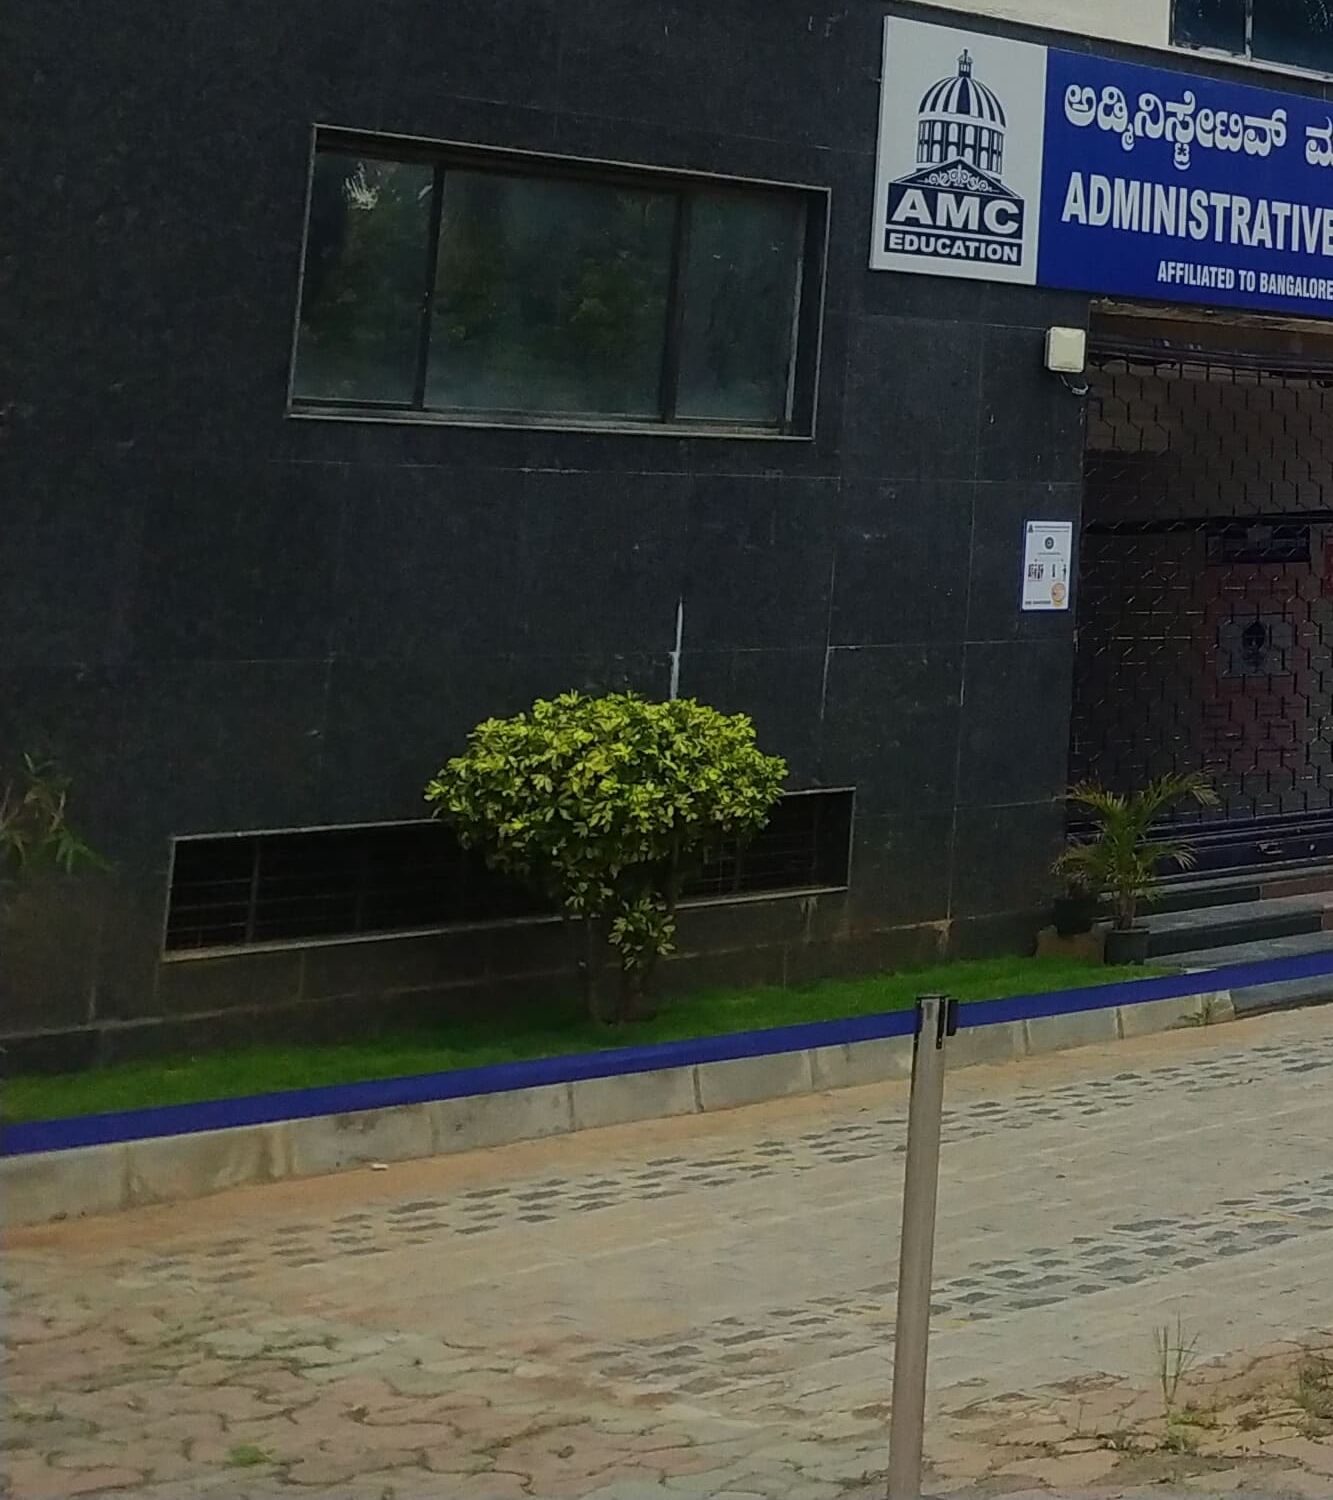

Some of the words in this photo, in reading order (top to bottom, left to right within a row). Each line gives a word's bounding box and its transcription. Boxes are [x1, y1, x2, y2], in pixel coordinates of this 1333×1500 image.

[891, 188, 1020, 235] AMC
[888, 233, 1018, 262] EDUCATION
[1157, 260, 1235, 289] AFFILIATED
[1238, 269, 1256, 292] TO
[1259, 272, 1333, 301] BANGALORE
